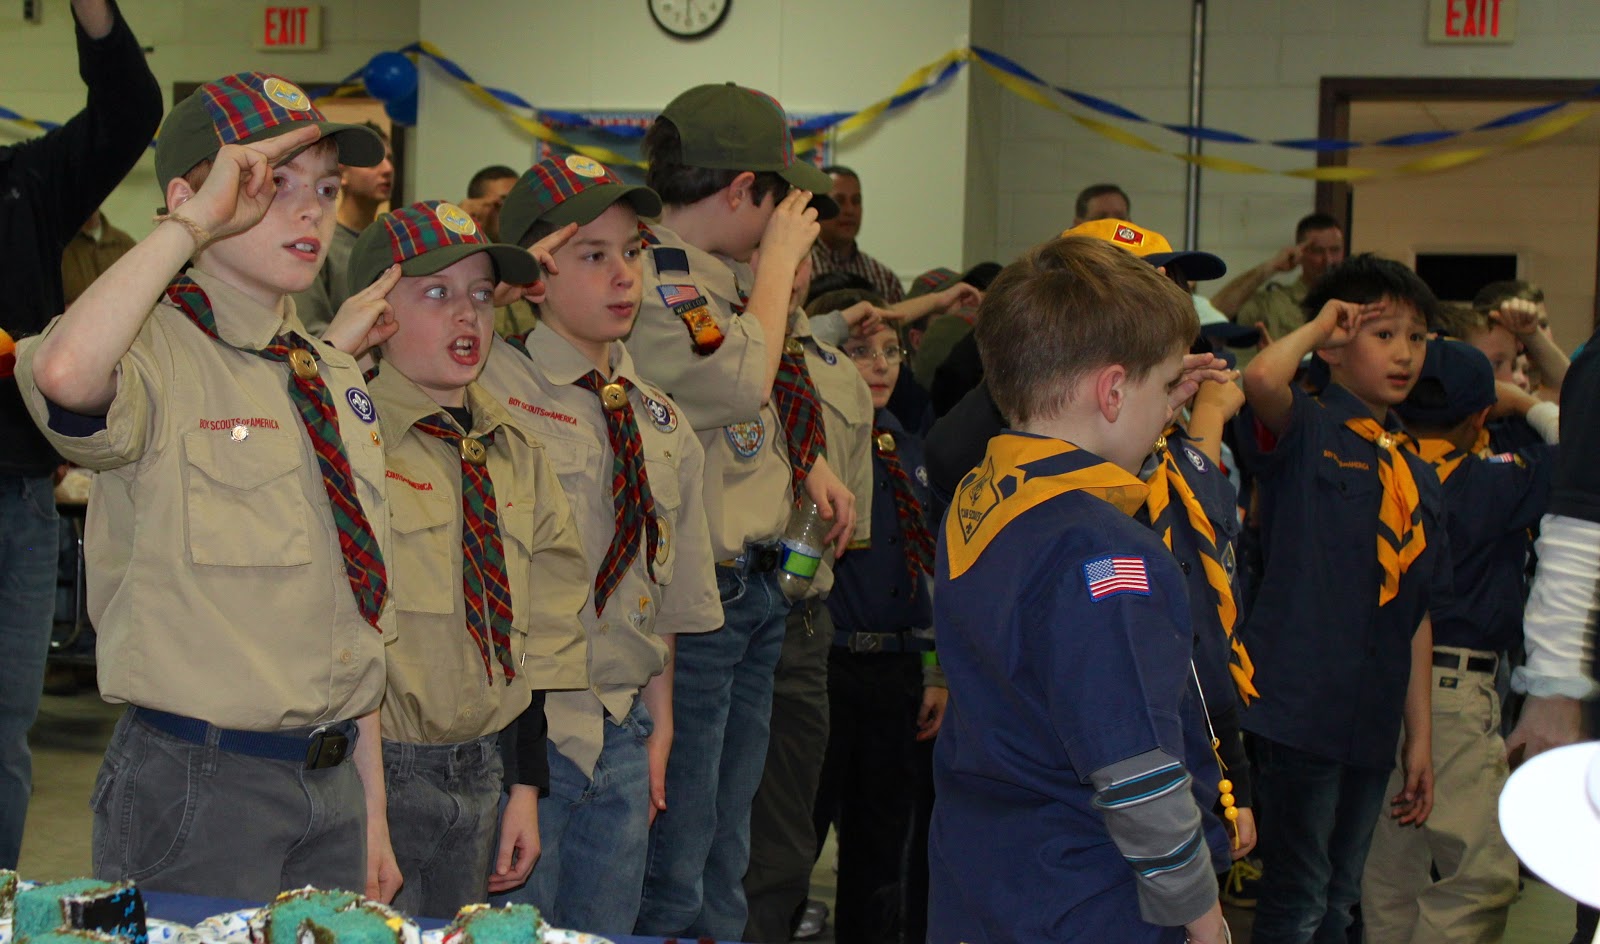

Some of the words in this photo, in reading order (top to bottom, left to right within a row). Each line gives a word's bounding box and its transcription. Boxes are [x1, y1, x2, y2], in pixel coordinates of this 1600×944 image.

[265, 6, 309, 46] EXIT
[1446, 0, 1500, 37] EXIT
[199, 419, 210, 429] BOY
[210, 418, 241, 430] SCOUTS
[250, 417, 279, 430] AMERICA
[509, 397, 521, 407] BOY
[521, 402, 545, 417] SCOUTS
[550, 411, 577, 426] AMERICA
